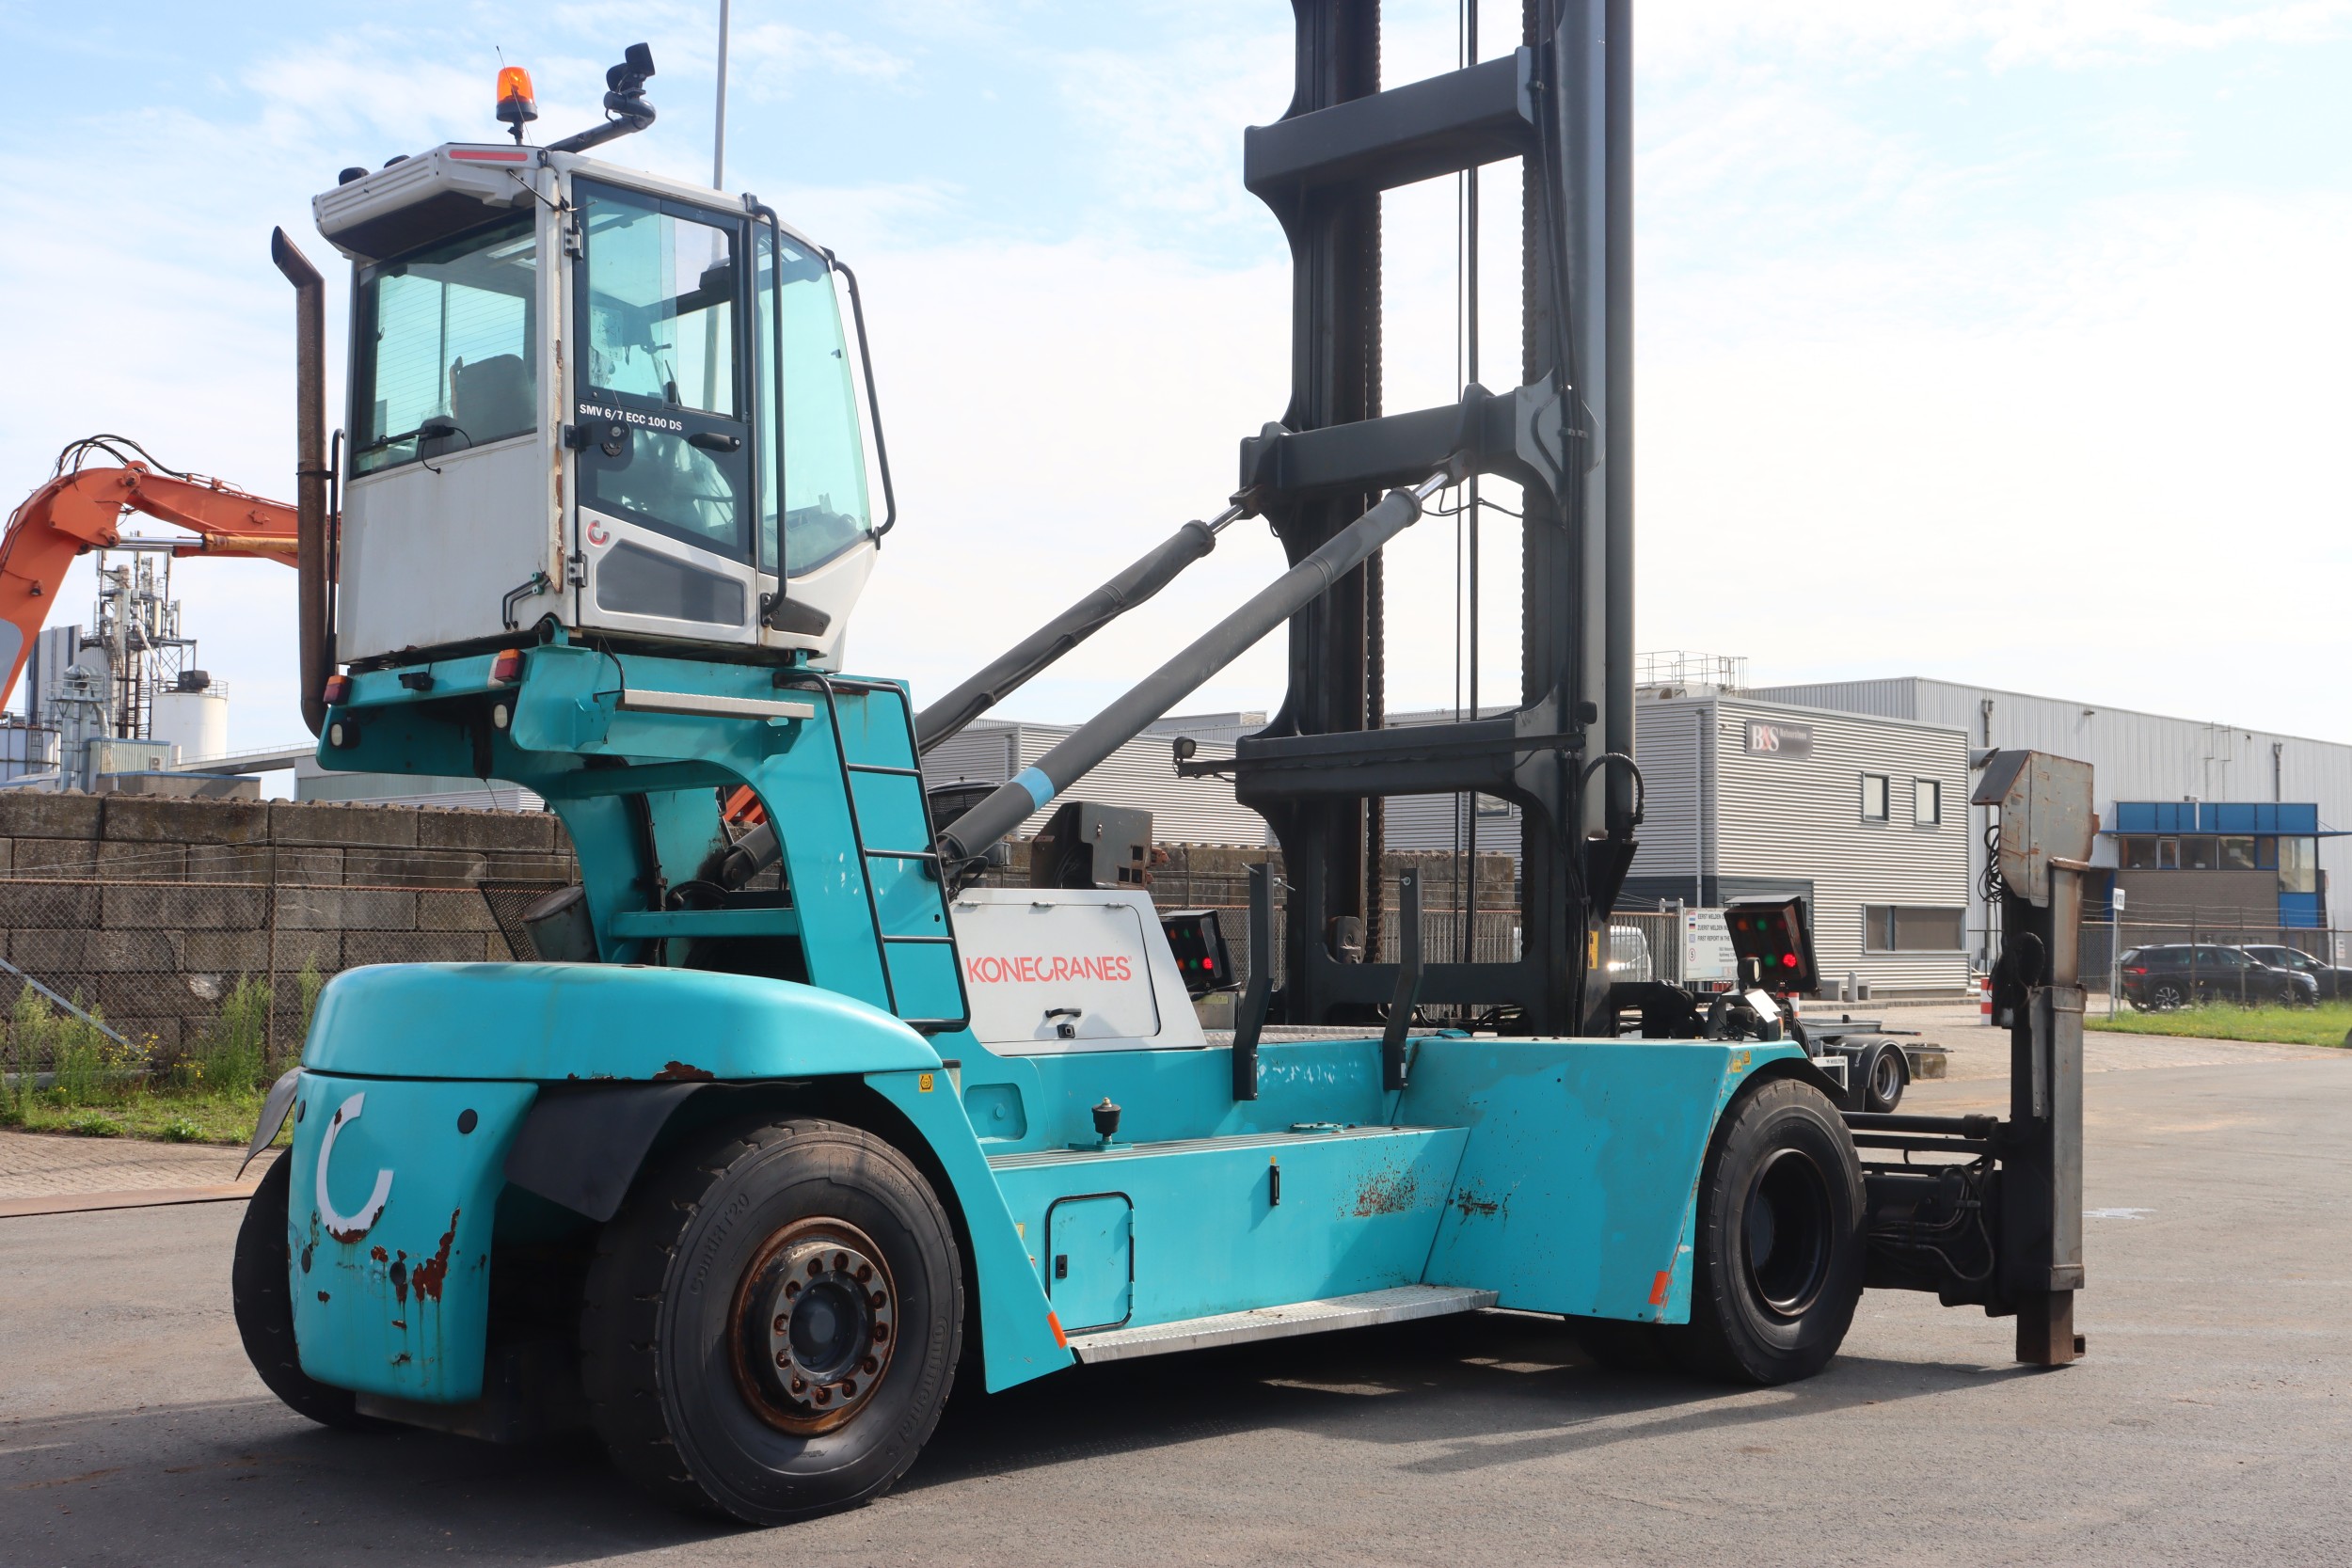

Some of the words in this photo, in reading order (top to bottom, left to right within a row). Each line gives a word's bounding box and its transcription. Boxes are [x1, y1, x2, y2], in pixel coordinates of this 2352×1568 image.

[580, 404, 602, 417] SMV
[605, 408, 623, 420] 6/7
[626, 412, 645, 424] ECC
[648, 416, 667, 428] 100
[669, 420, 682, 431] DS
[966, 956, 1131, 983] KONECRANES
